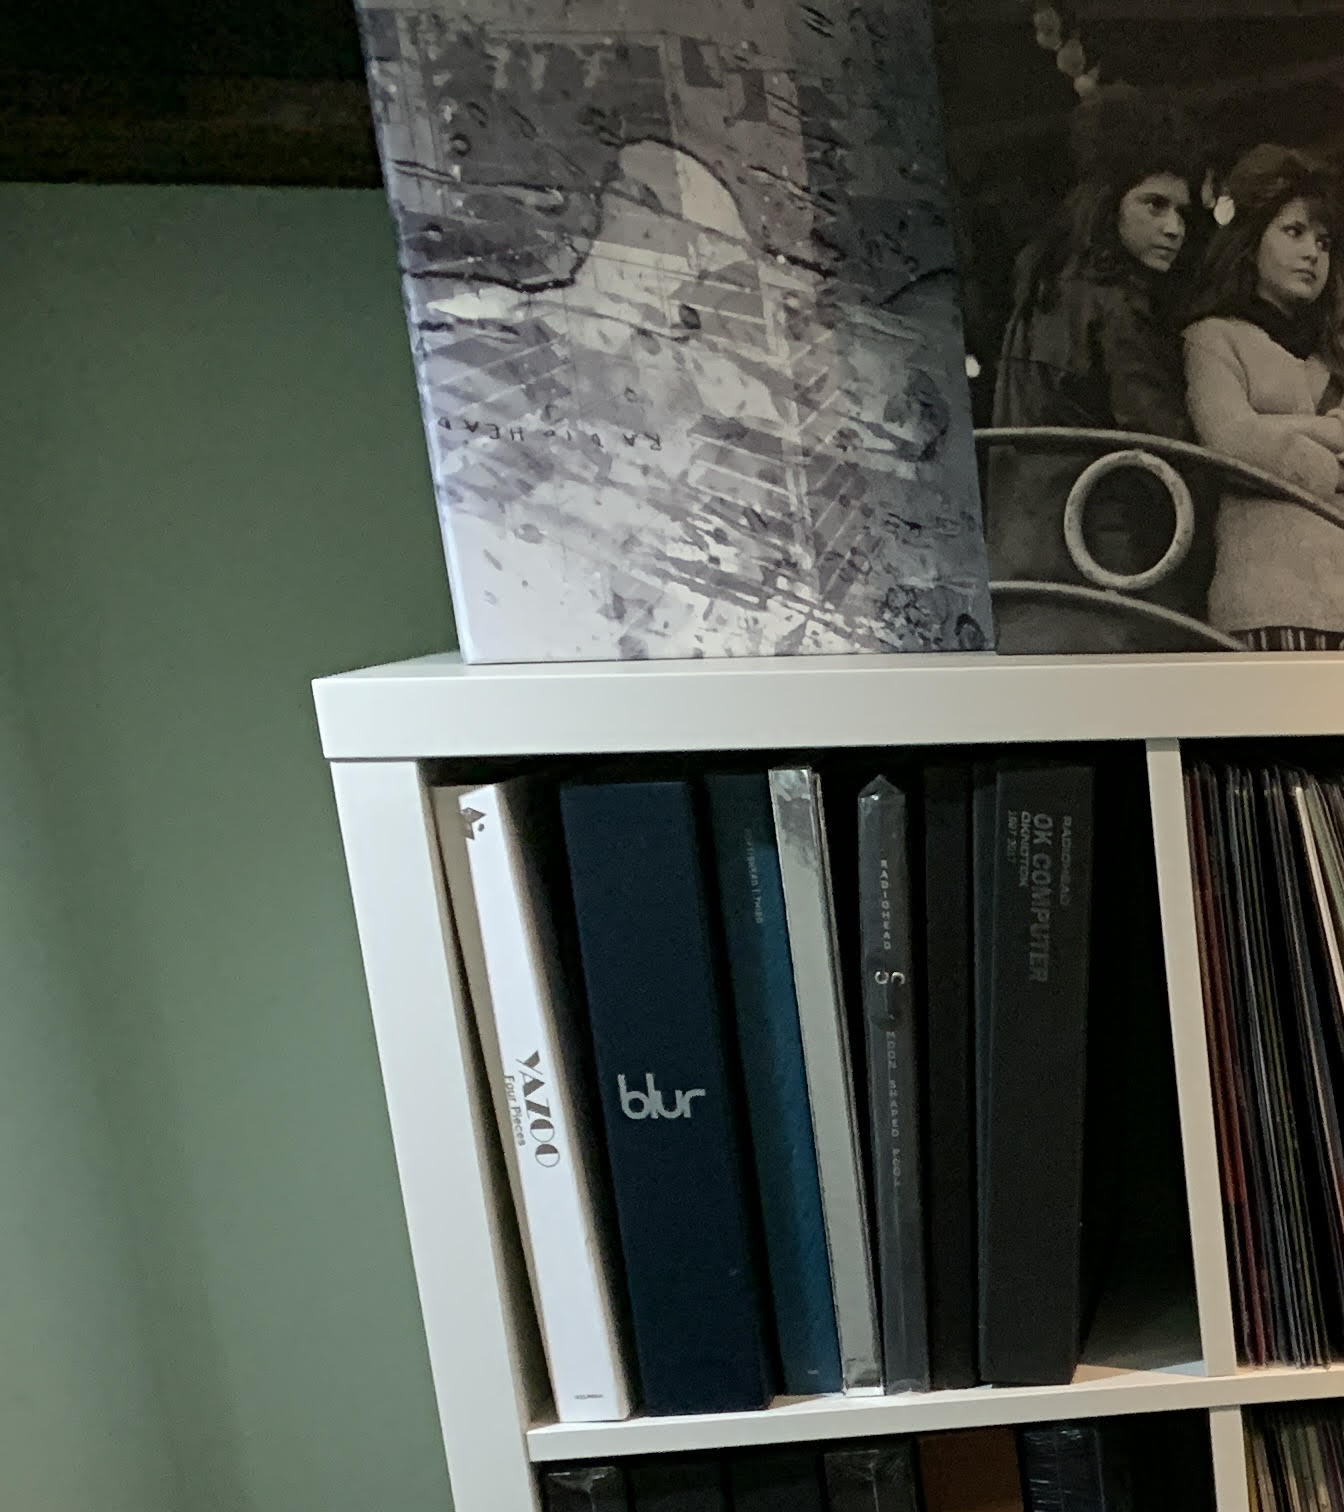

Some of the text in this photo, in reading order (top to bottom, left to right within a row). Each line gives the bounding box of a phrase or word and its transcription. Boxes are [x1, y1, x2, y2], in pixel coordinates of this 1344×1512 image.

[878, 857, 892, 951] RADIOHEAD
[1029, 812, 1053, 983] OK COMPUTER
[502, 1072, 529, 1147] Four Pieces
[514, 1049, 561, 1169] YAZOO
[617, 1072, 706, 1120] blur
